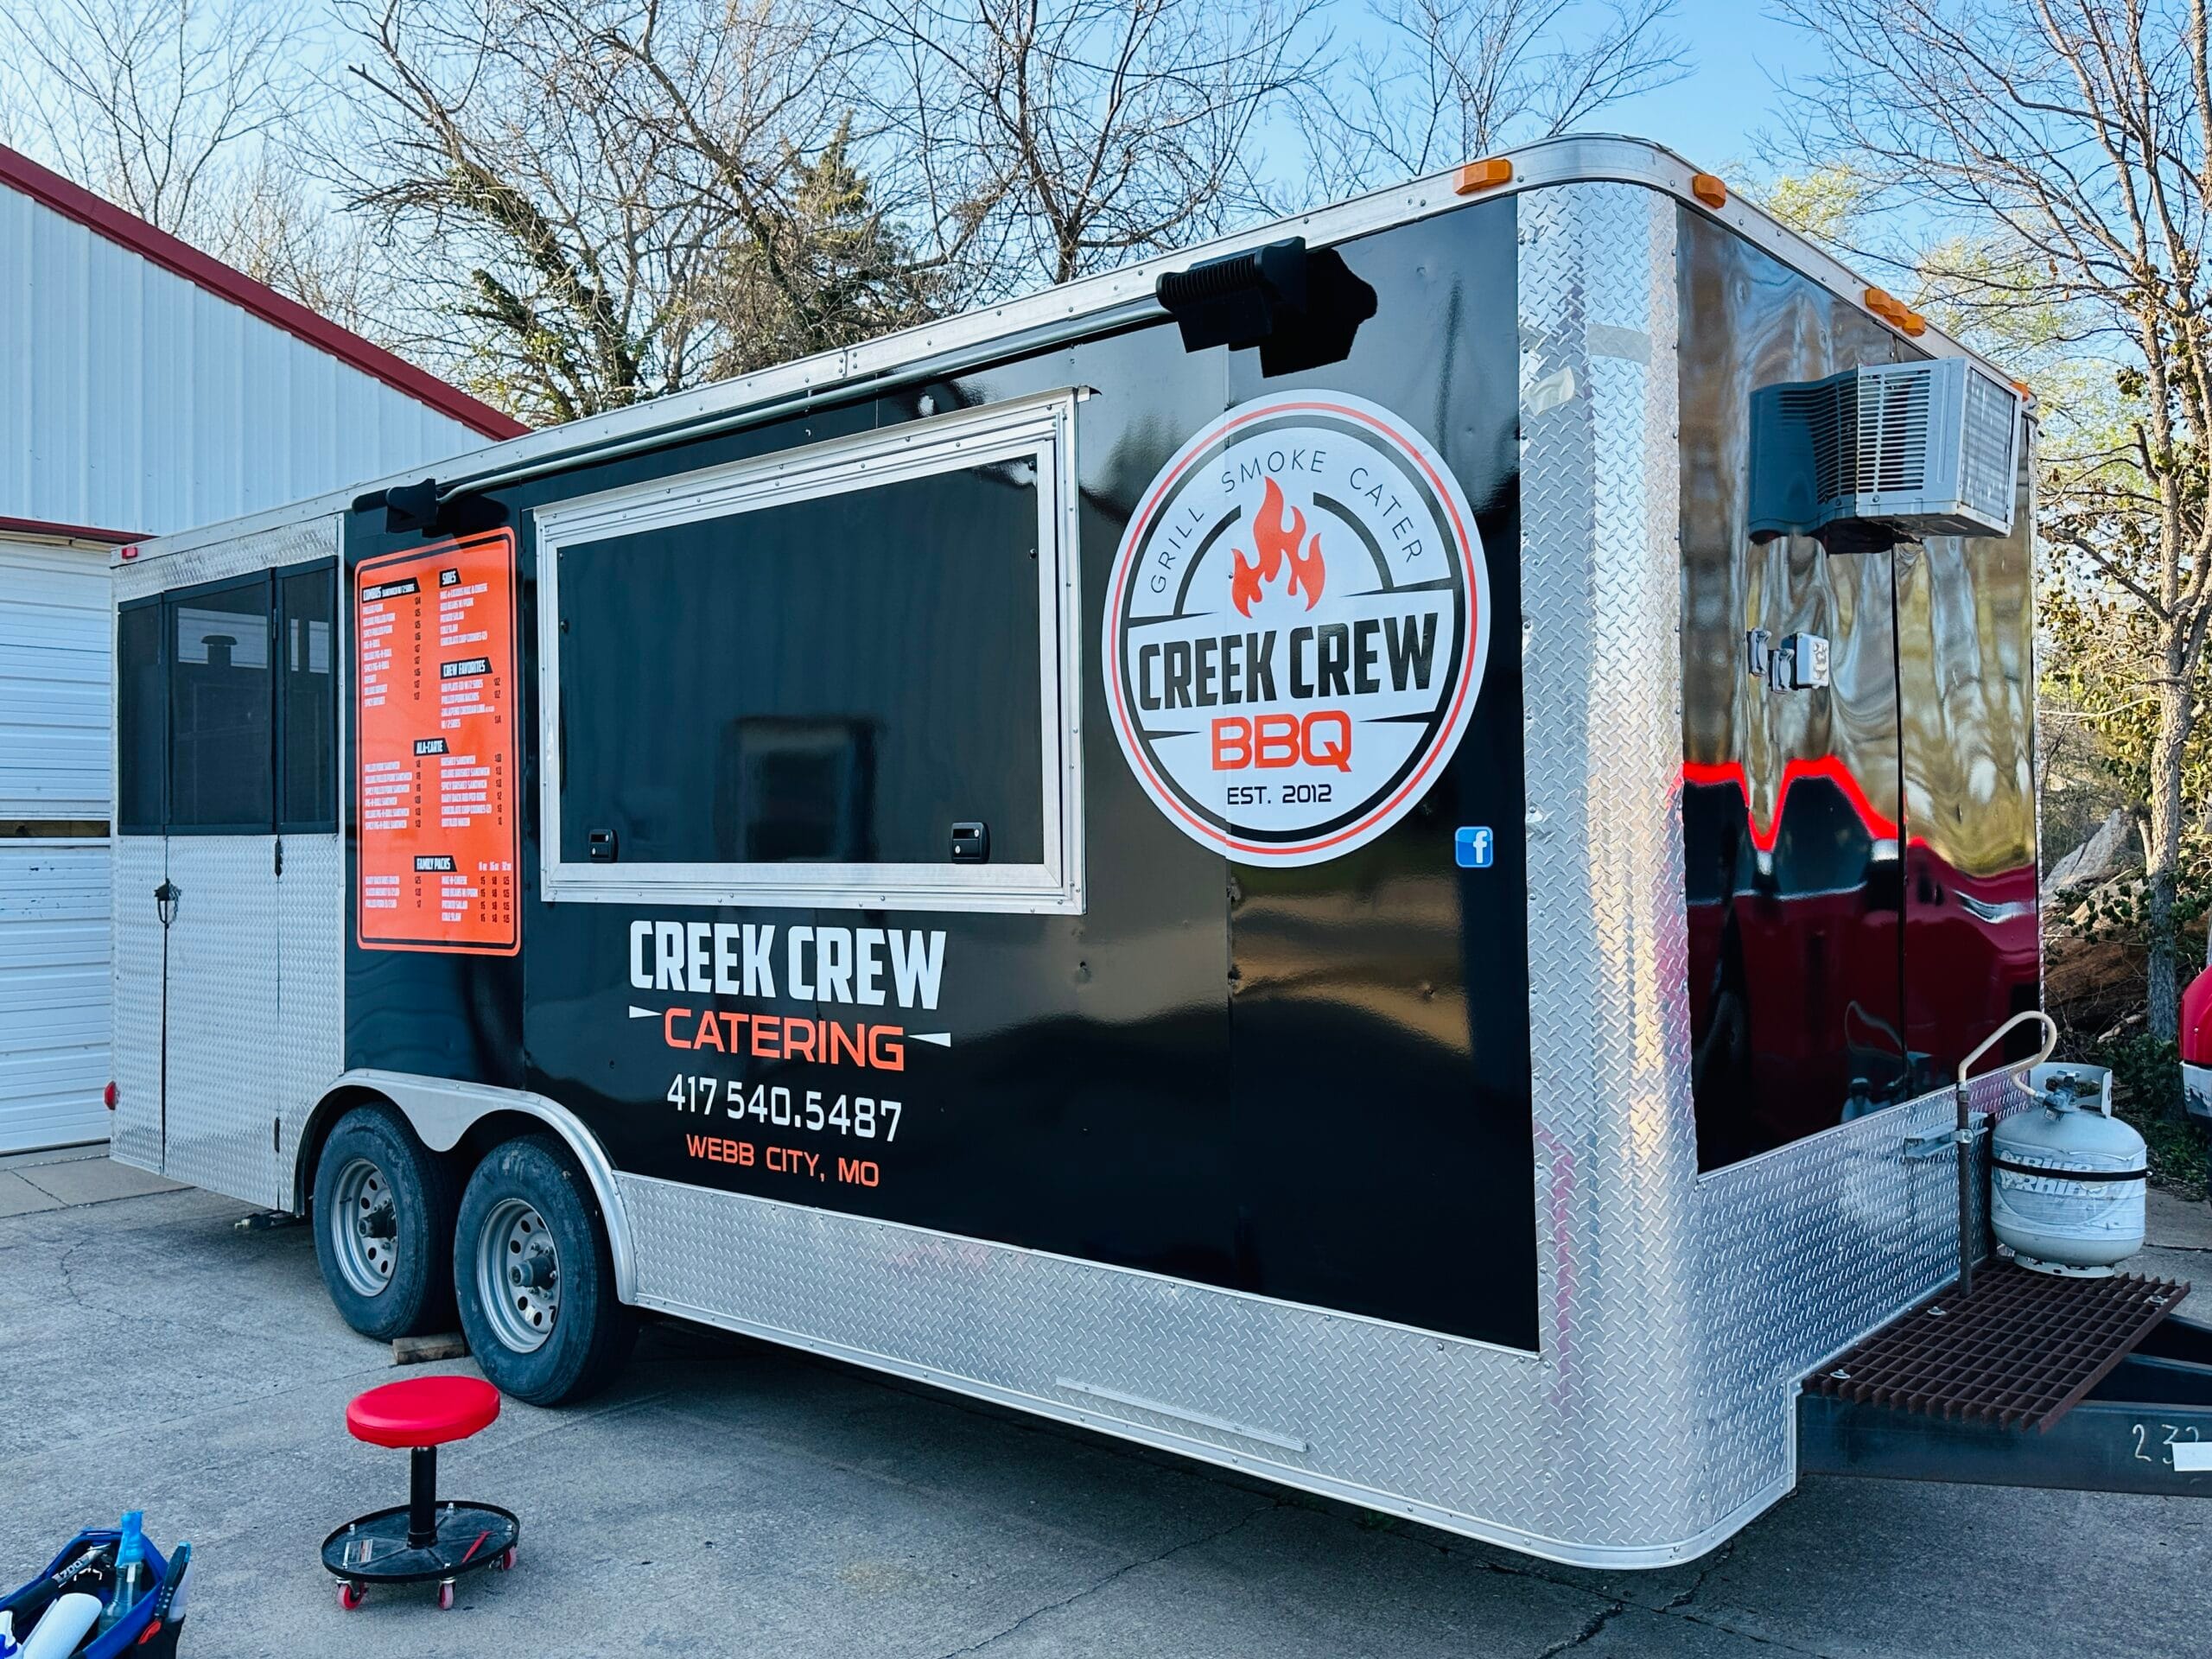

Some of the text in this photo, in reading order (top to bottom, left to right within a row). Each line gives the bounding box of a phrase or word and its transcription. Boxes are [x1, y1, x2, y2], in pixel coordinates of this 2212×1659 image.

[1150, 448, 1423, 594] GRILL SMOKE CATER
[1139, 612, 1439, 711] CREEK CREW
[1211, 710, 1351, 772] BBQ
[1227, 784, 1332, 805] EST. 2012
[630, 920, 947, 1010] CREEK CREW
[664, 1007, 905, 1071] CATERING
[666, 1073, 902, 1142] 417 540.5487
[686, 1134, 880, 1187] WEBB CITY, MO
